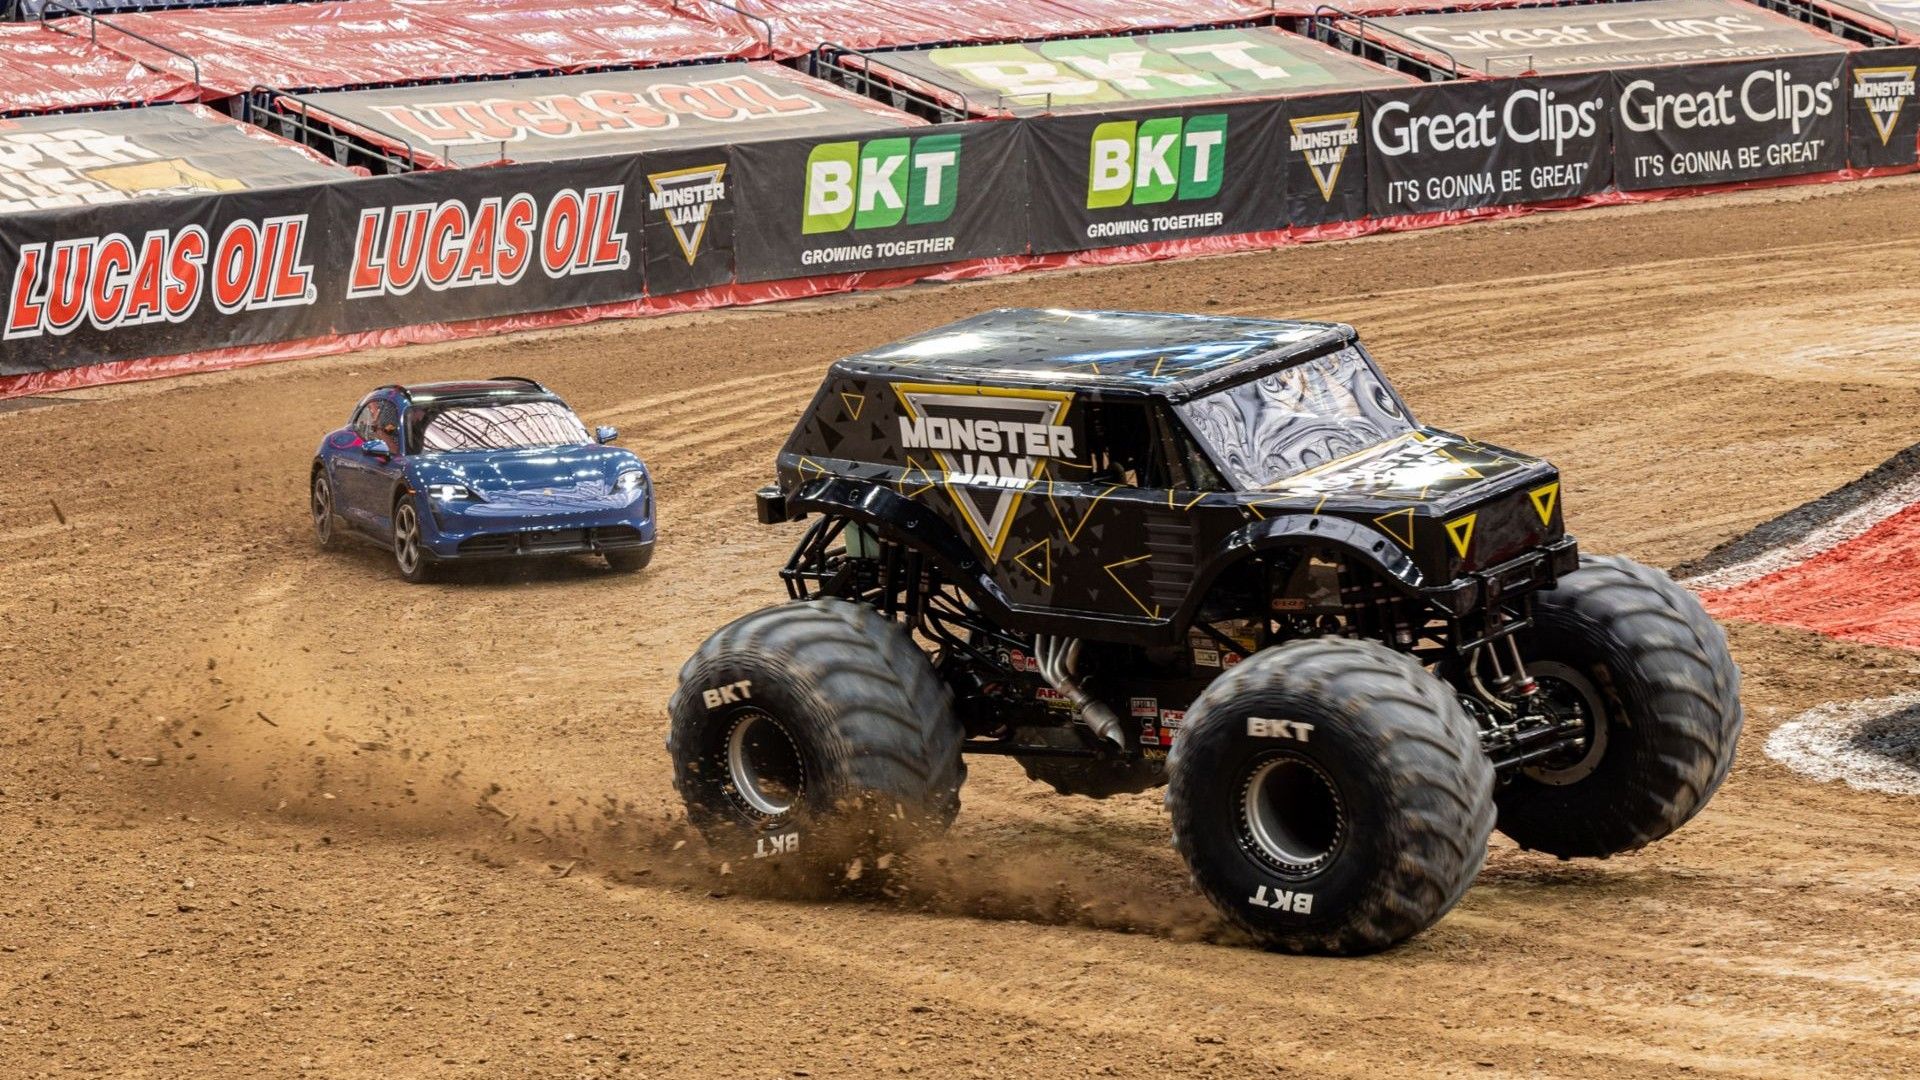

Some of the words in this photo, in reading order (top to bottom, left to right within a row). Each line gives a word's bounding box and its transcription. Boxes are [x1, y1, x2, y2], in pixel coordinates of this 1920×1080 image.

[949, 41, 1290, 95] BKT
[1619, 80, 1736, 132] Great
[1740, 69, 1834, 134] Clips
[1854, 81, 1915, 98] MONSTER
[1870, 97, 1902, 113] JAM
[1371, 101, 1497, 156] Great
[1503, 88, 1597, 156] Clips
[1290, 128, 1359, 151] MONSTER
[1092, 130, 1223, 192] BKT
[1309, 147, 1344, 166] JAM
[1635, 155, 1665, 178] IT'S
[1671, 150, 1733, 175] GONNA
[1738, 147, 1760, 168] BE
[1767, 140, 1821, 163] GREAT
[649, 182, 726, 210] MONSTER
[807, 151, 955, 216] BKT
[1388, 179, 1420, 204] IT'S
[1426, 172, 1495, 200] GONNA
[1501, 169, 1522, 192] BE
[1530, 163, 1583, 190] GREAT
[669, 203, 707, 226] JAM
[1087, 219, 1149, 238] GROWING
[1152, 212, 1223, 232] TOGETHER
[346, 192, 538, 299] LUCAS
[540, 185, 627, 279] OIL
[801, 245, 872, 266] GROWING
[876, 237, 955, 259] TOGETHER
[2, 224, 209, 340] LUCAS
[212, 214, 314, 314] OIL
[899, 416, 1075, 459] MONSTER
[949, 453, 1035, 489] JAM
[703, 680, 752, 709] BKT
[1247, 717, 1315, 742] BKT
[753, 832, 799, 858] BKT
[1249, 885, 1314, 914] BKT
